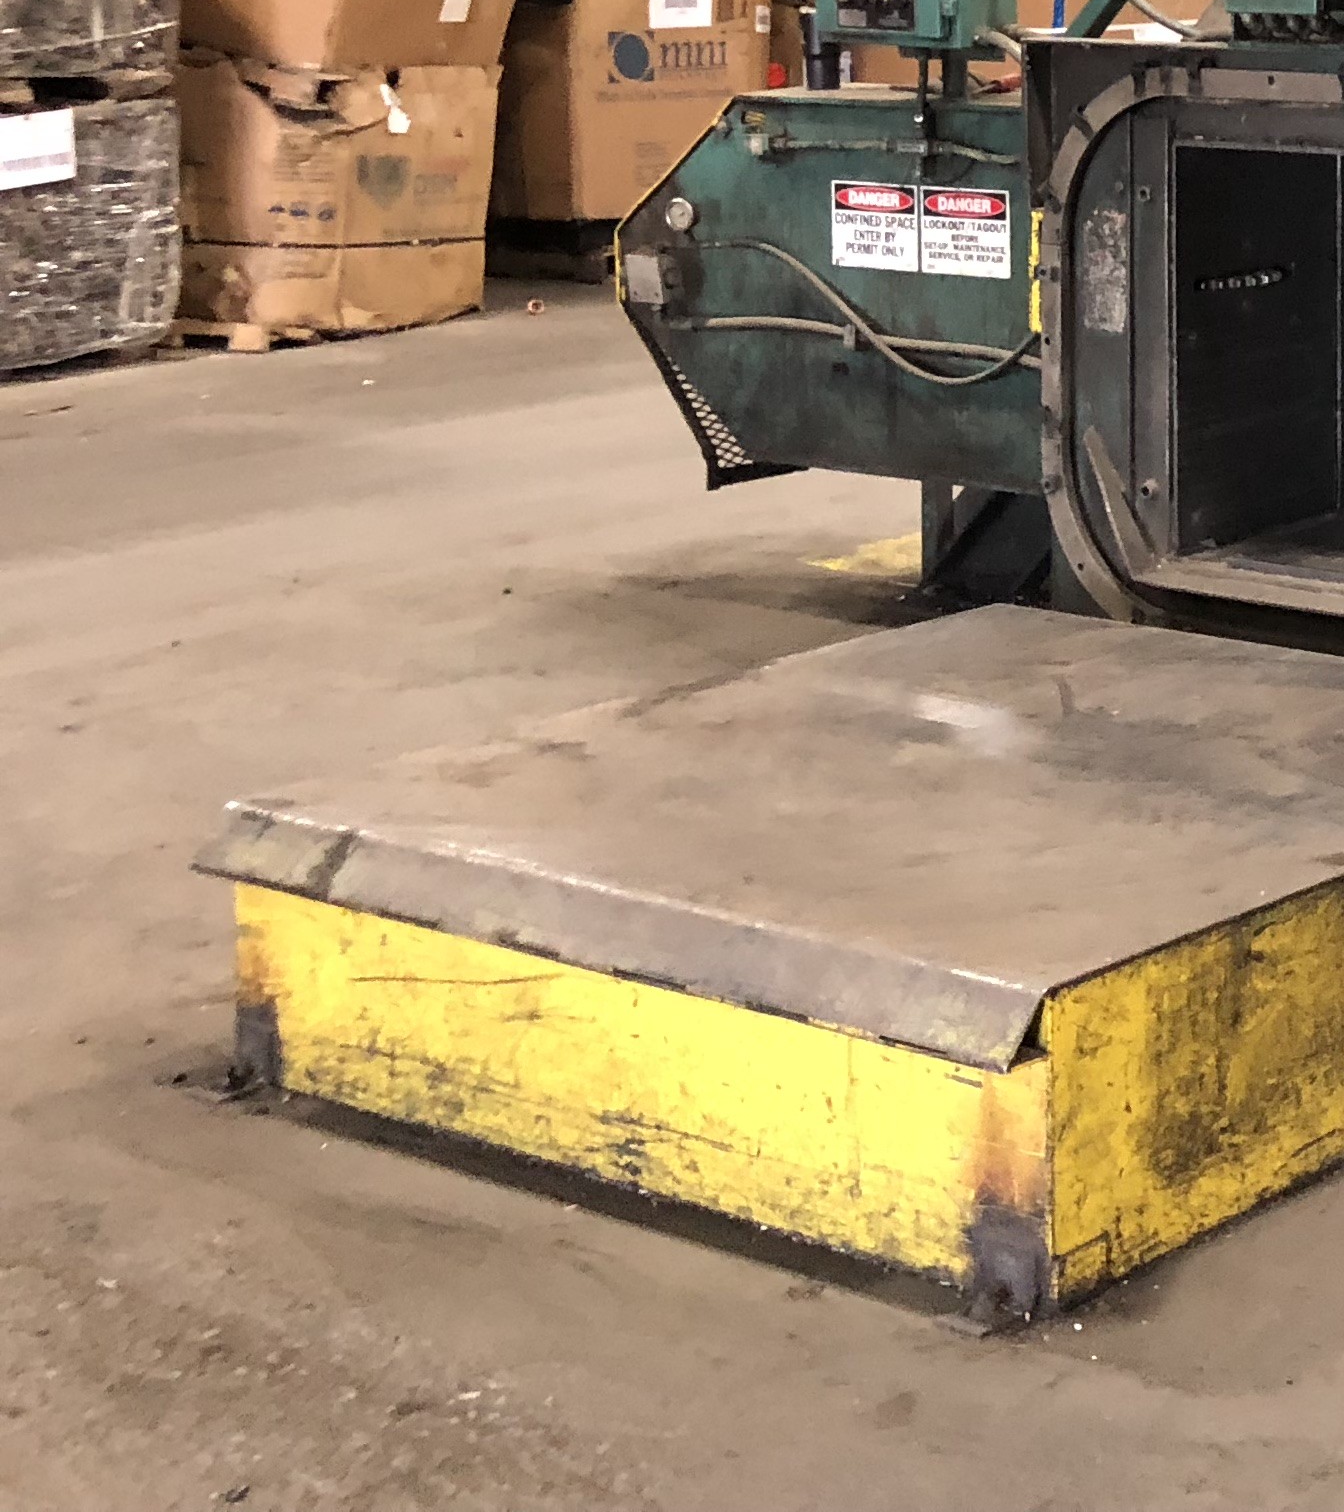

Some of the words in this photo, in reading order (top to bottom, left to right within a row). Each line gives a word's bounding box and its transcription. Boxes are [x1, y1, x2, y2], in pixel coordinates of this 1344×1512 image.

[848, 190, 900, 207] DANGER
[938, 197, 991, 213] DANGER
[835, 212, 882, 227] CONFINED
[884, 215, 916, 230] SPACE
[854, 229, 882, 242] ENTER
[884, 231, 897, 243] BY
[845, 242, 879, 255] PERMIT
[881, 244, 905, 257] ONLY
[976, 254, 1004, 264] REPAIR
